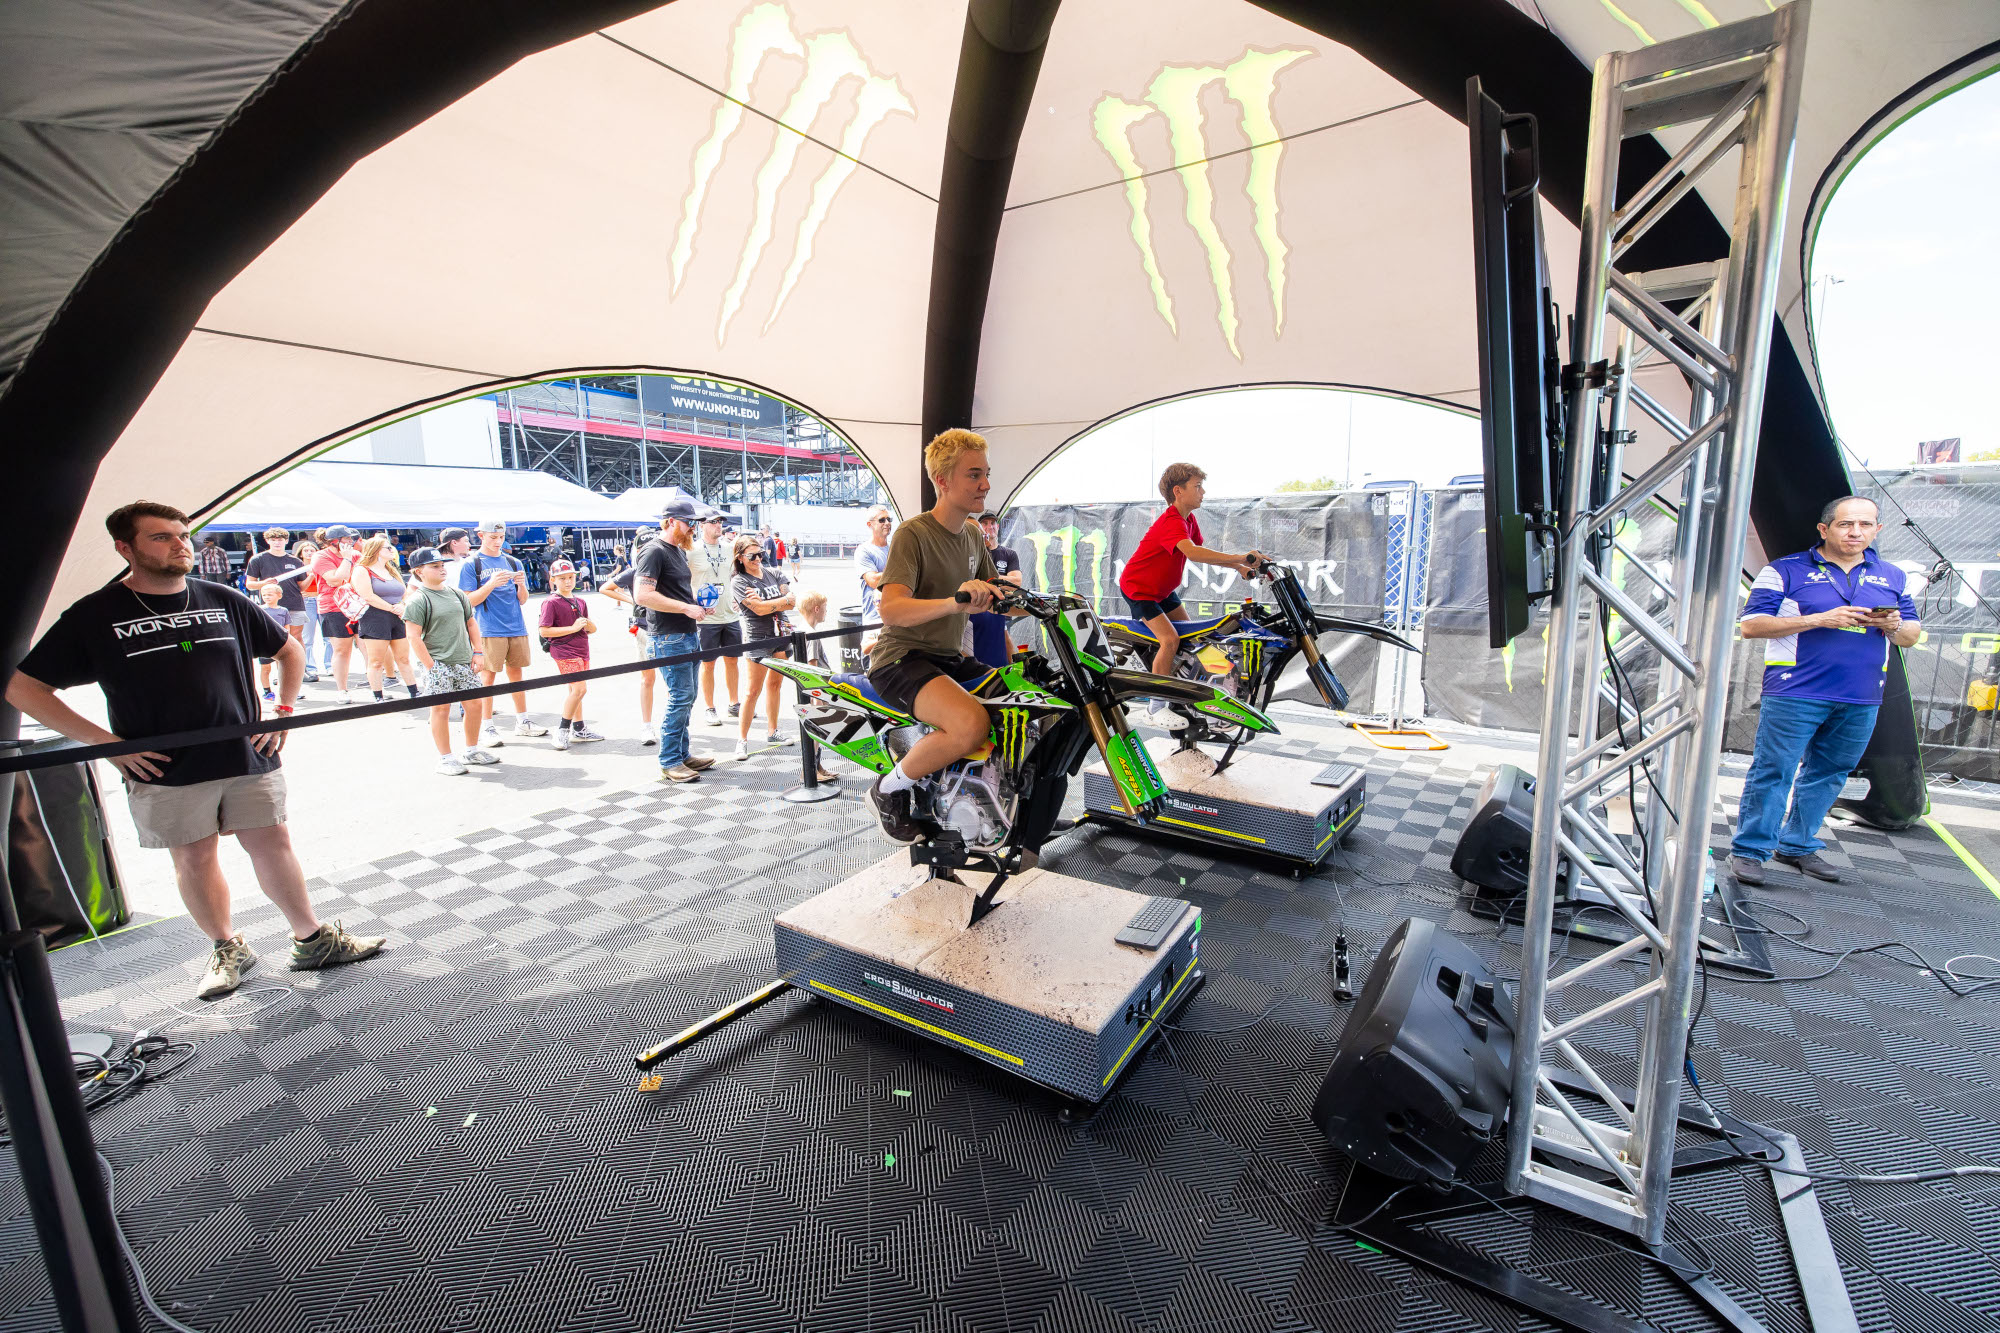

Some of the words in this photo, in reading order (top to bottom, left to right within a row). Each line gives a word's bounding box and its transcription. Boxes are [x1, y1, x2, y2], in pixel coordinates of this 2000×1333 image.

[670, 383, 701, 394] UNIVERSITY
[708, 391, 748, 403] NORTHWESTERN
[671, 396, 760, 420] WWW.UNOH.EDU
[113, 611, 229, 640] MONSTER
[783, 666, 810, 682] DUNLOP
[1117, 755, 1142, 798] ACERBIS
